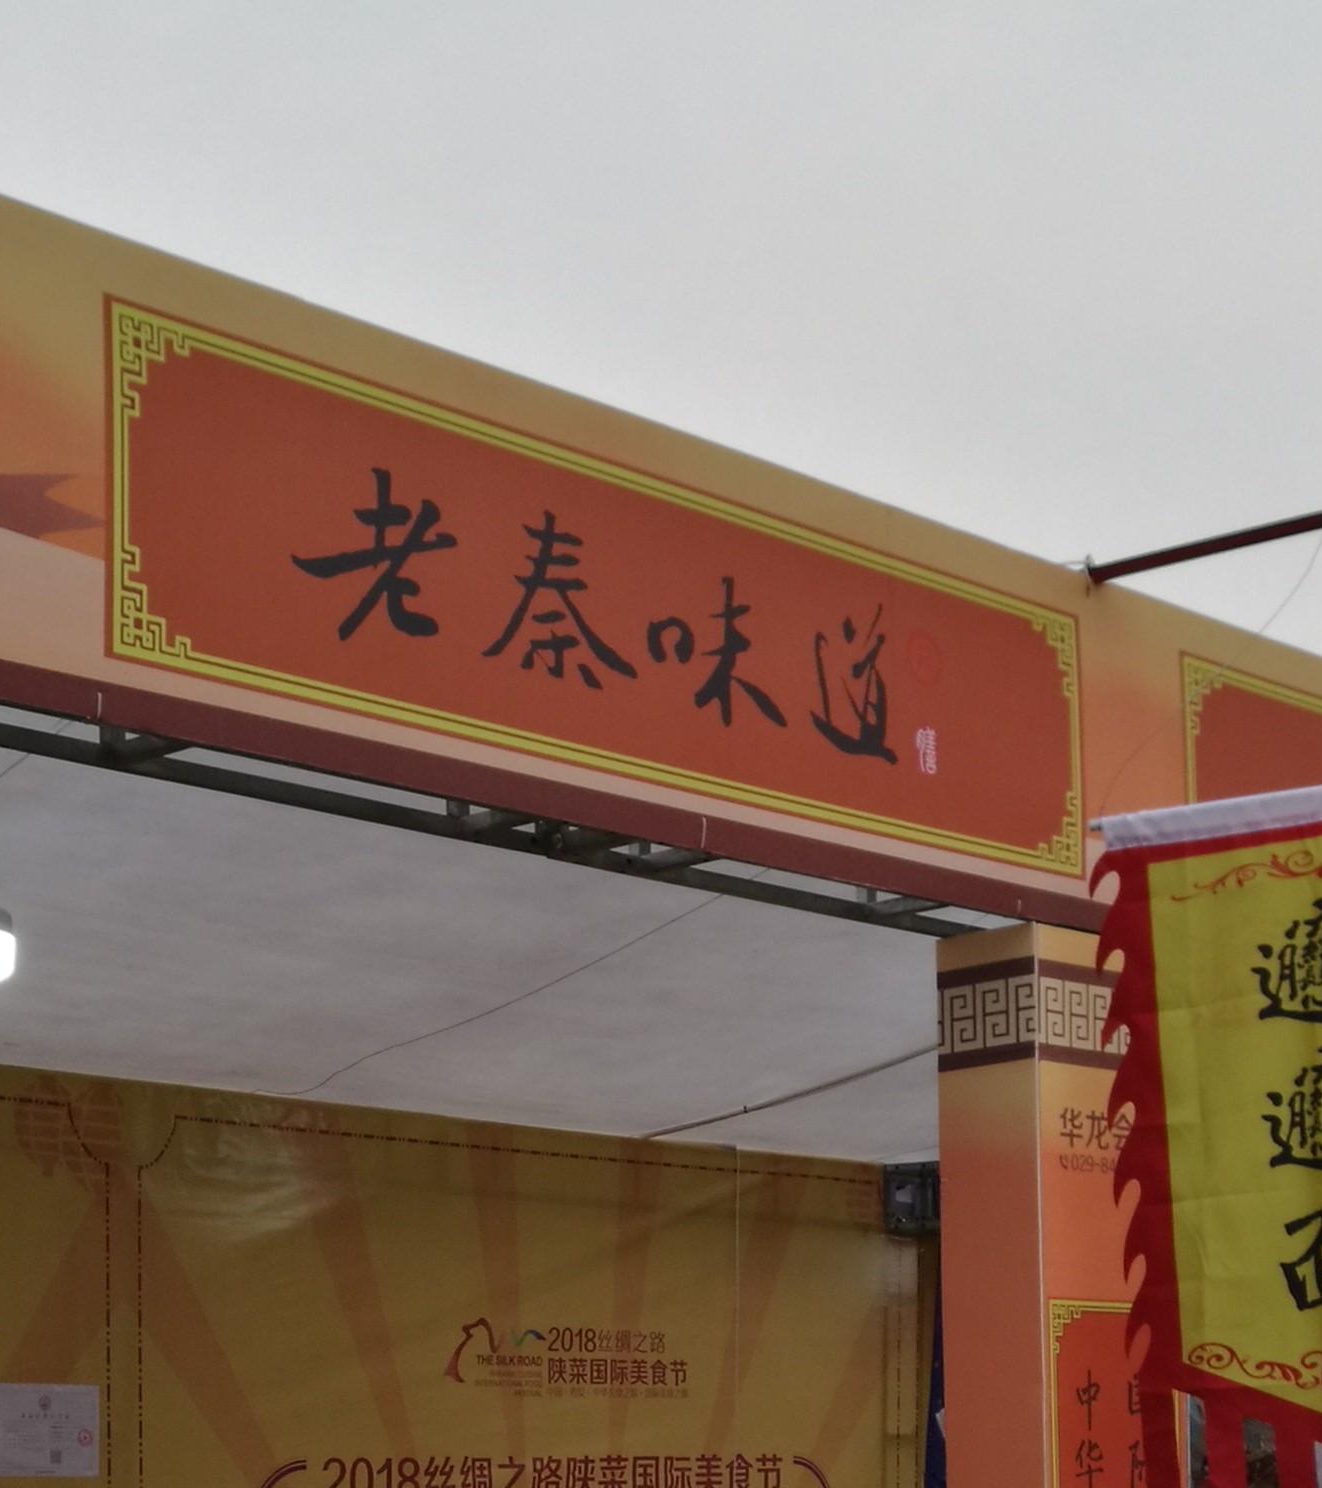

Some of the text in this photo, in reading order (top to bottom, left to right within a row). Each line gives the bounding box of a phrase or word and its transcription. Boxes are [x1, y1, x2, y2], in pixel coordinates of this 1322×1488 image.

[292, 468, 897, 765] 老秦味道
[547, 1325, 666, 1354] 2018丝绸之路
[547, 1358, 689, 1387] 陕菜国际美食节
